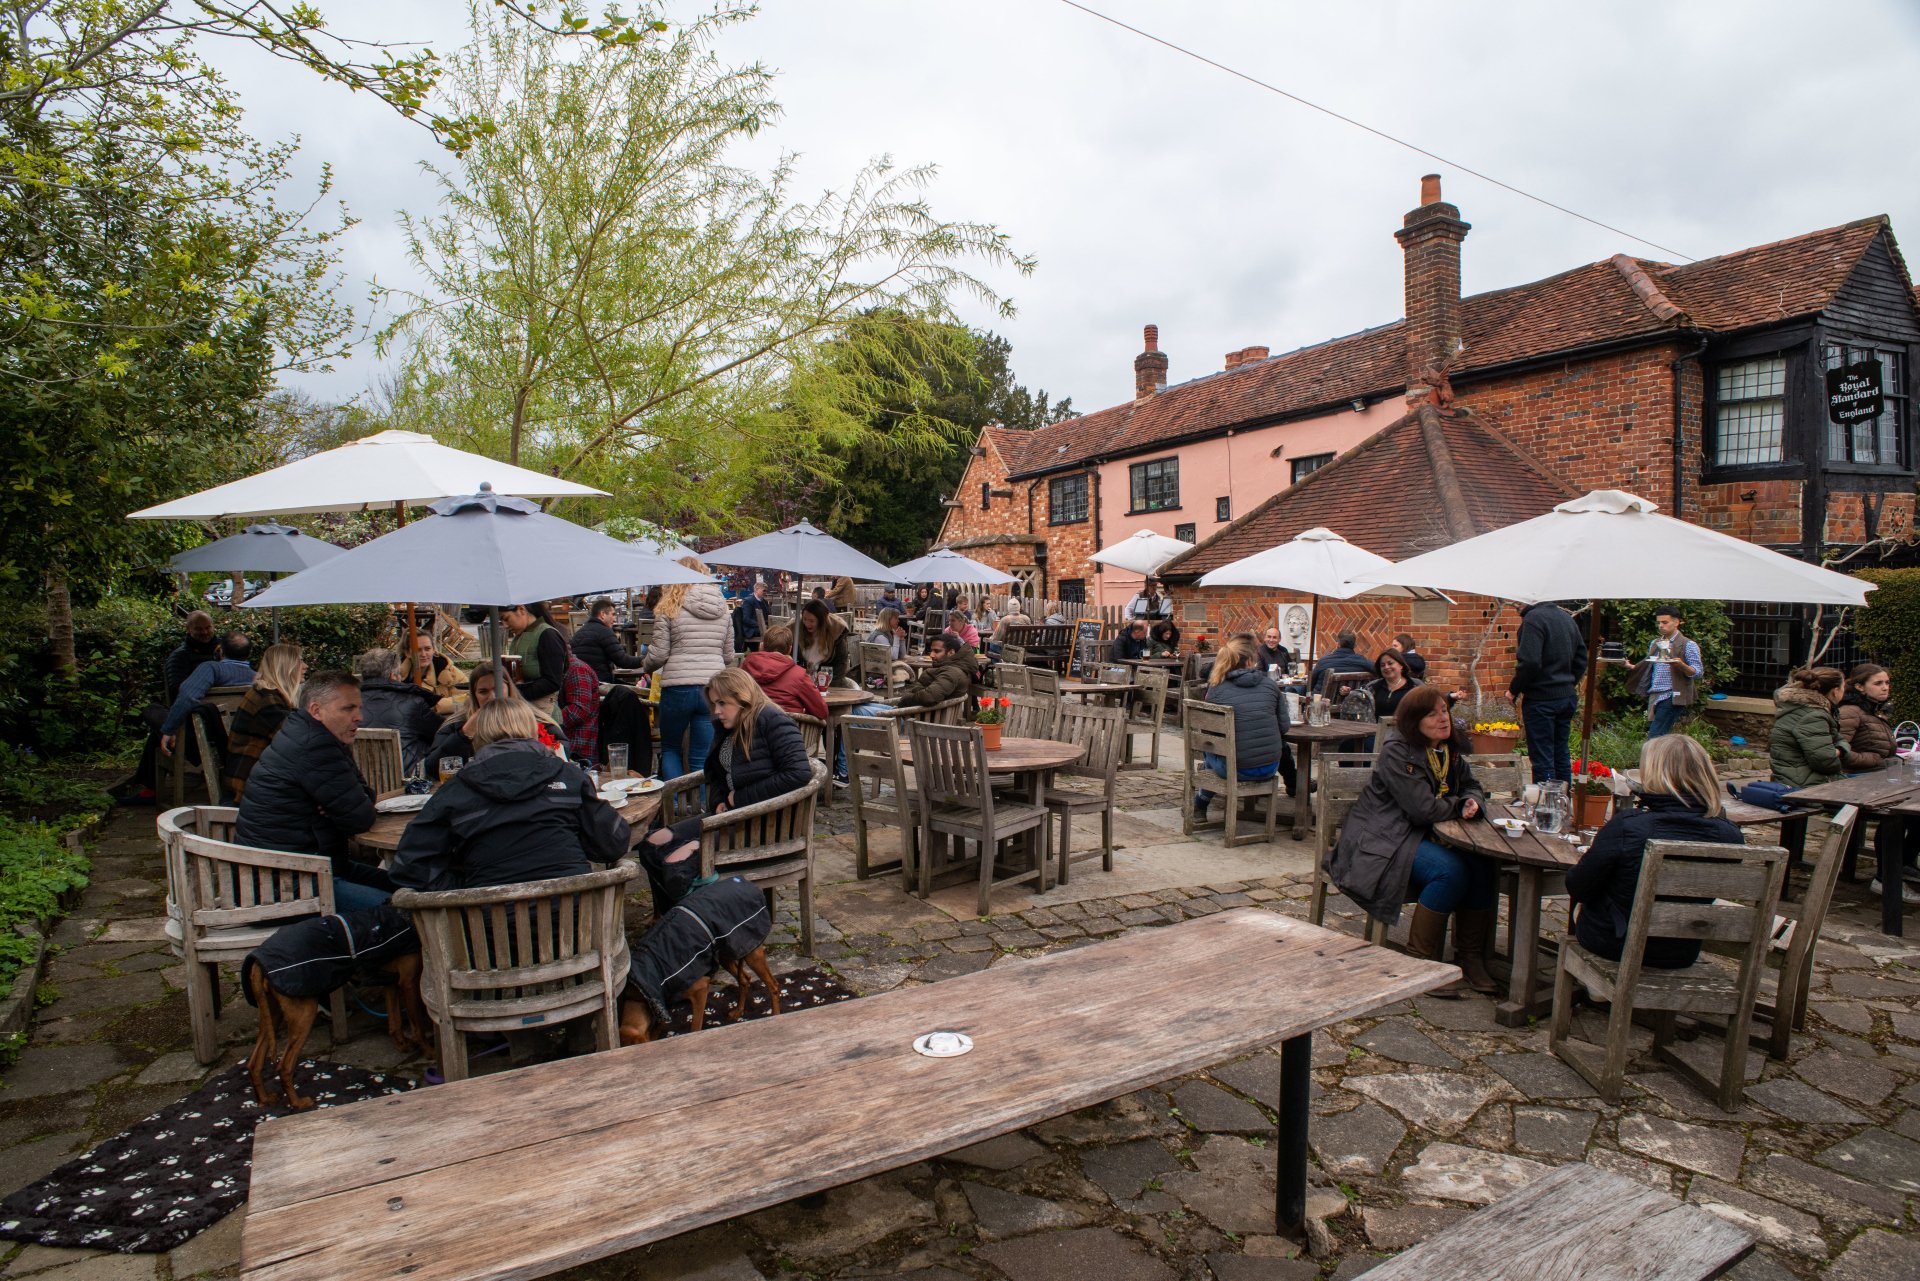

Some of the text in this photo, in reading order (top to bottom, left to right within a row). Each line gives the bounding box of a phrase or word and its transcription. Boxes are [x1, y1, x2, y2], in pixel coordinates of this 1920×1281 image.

[1839, 377, 1870, 393] Royal
[1831, 387, 1879, 406] Standard
[1839, 405, 1875, 419] England
